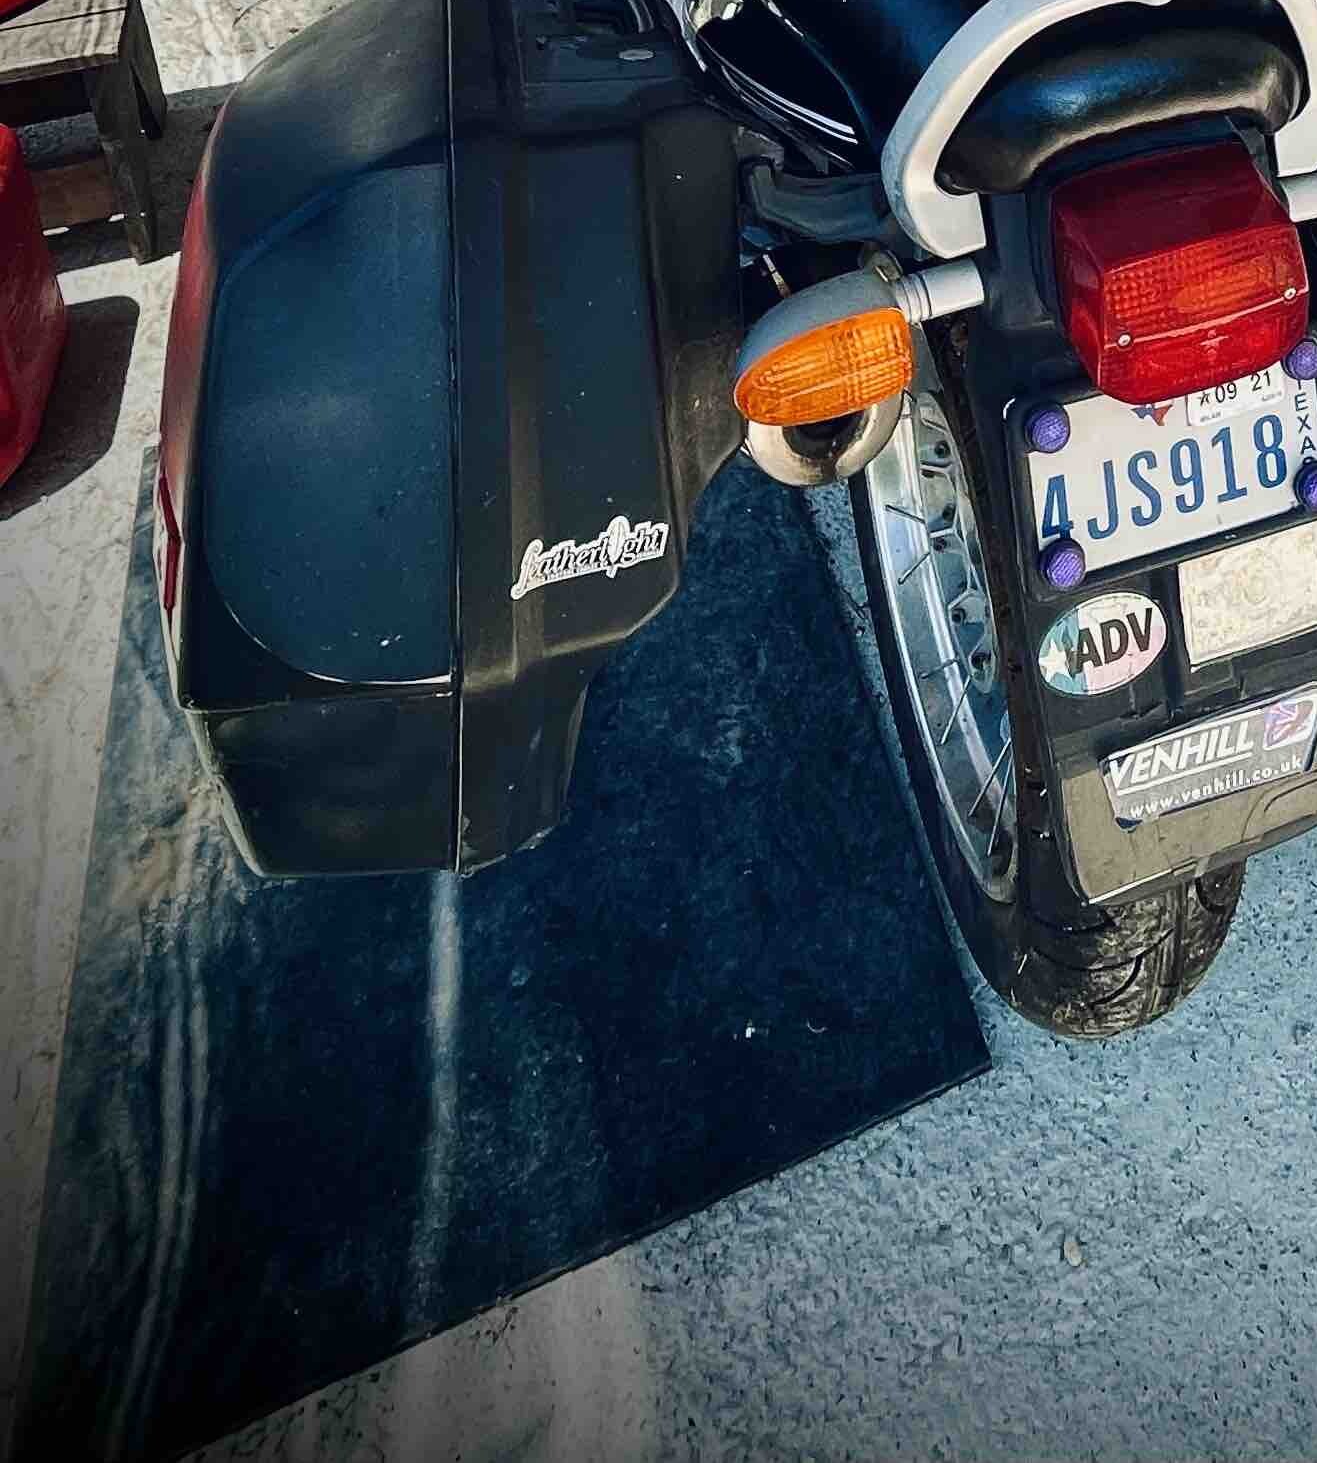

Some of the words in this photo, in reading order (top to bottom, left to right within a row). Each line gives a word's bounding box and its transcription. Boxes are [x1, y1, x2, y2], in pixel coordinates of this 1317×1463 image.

[1215, 382, 1237, 404] 09
[1250, 370, 1271, 392] 21
[1294, 379, 1317, 463] EXA
[1041, 414, 1287, 540] 4JS918
[1065, 607, 1152, 676] ADV
[1109, 720, 1254, 788] VENHILL
[1130, 754, 1304, 818] www.venhill.co.uk
